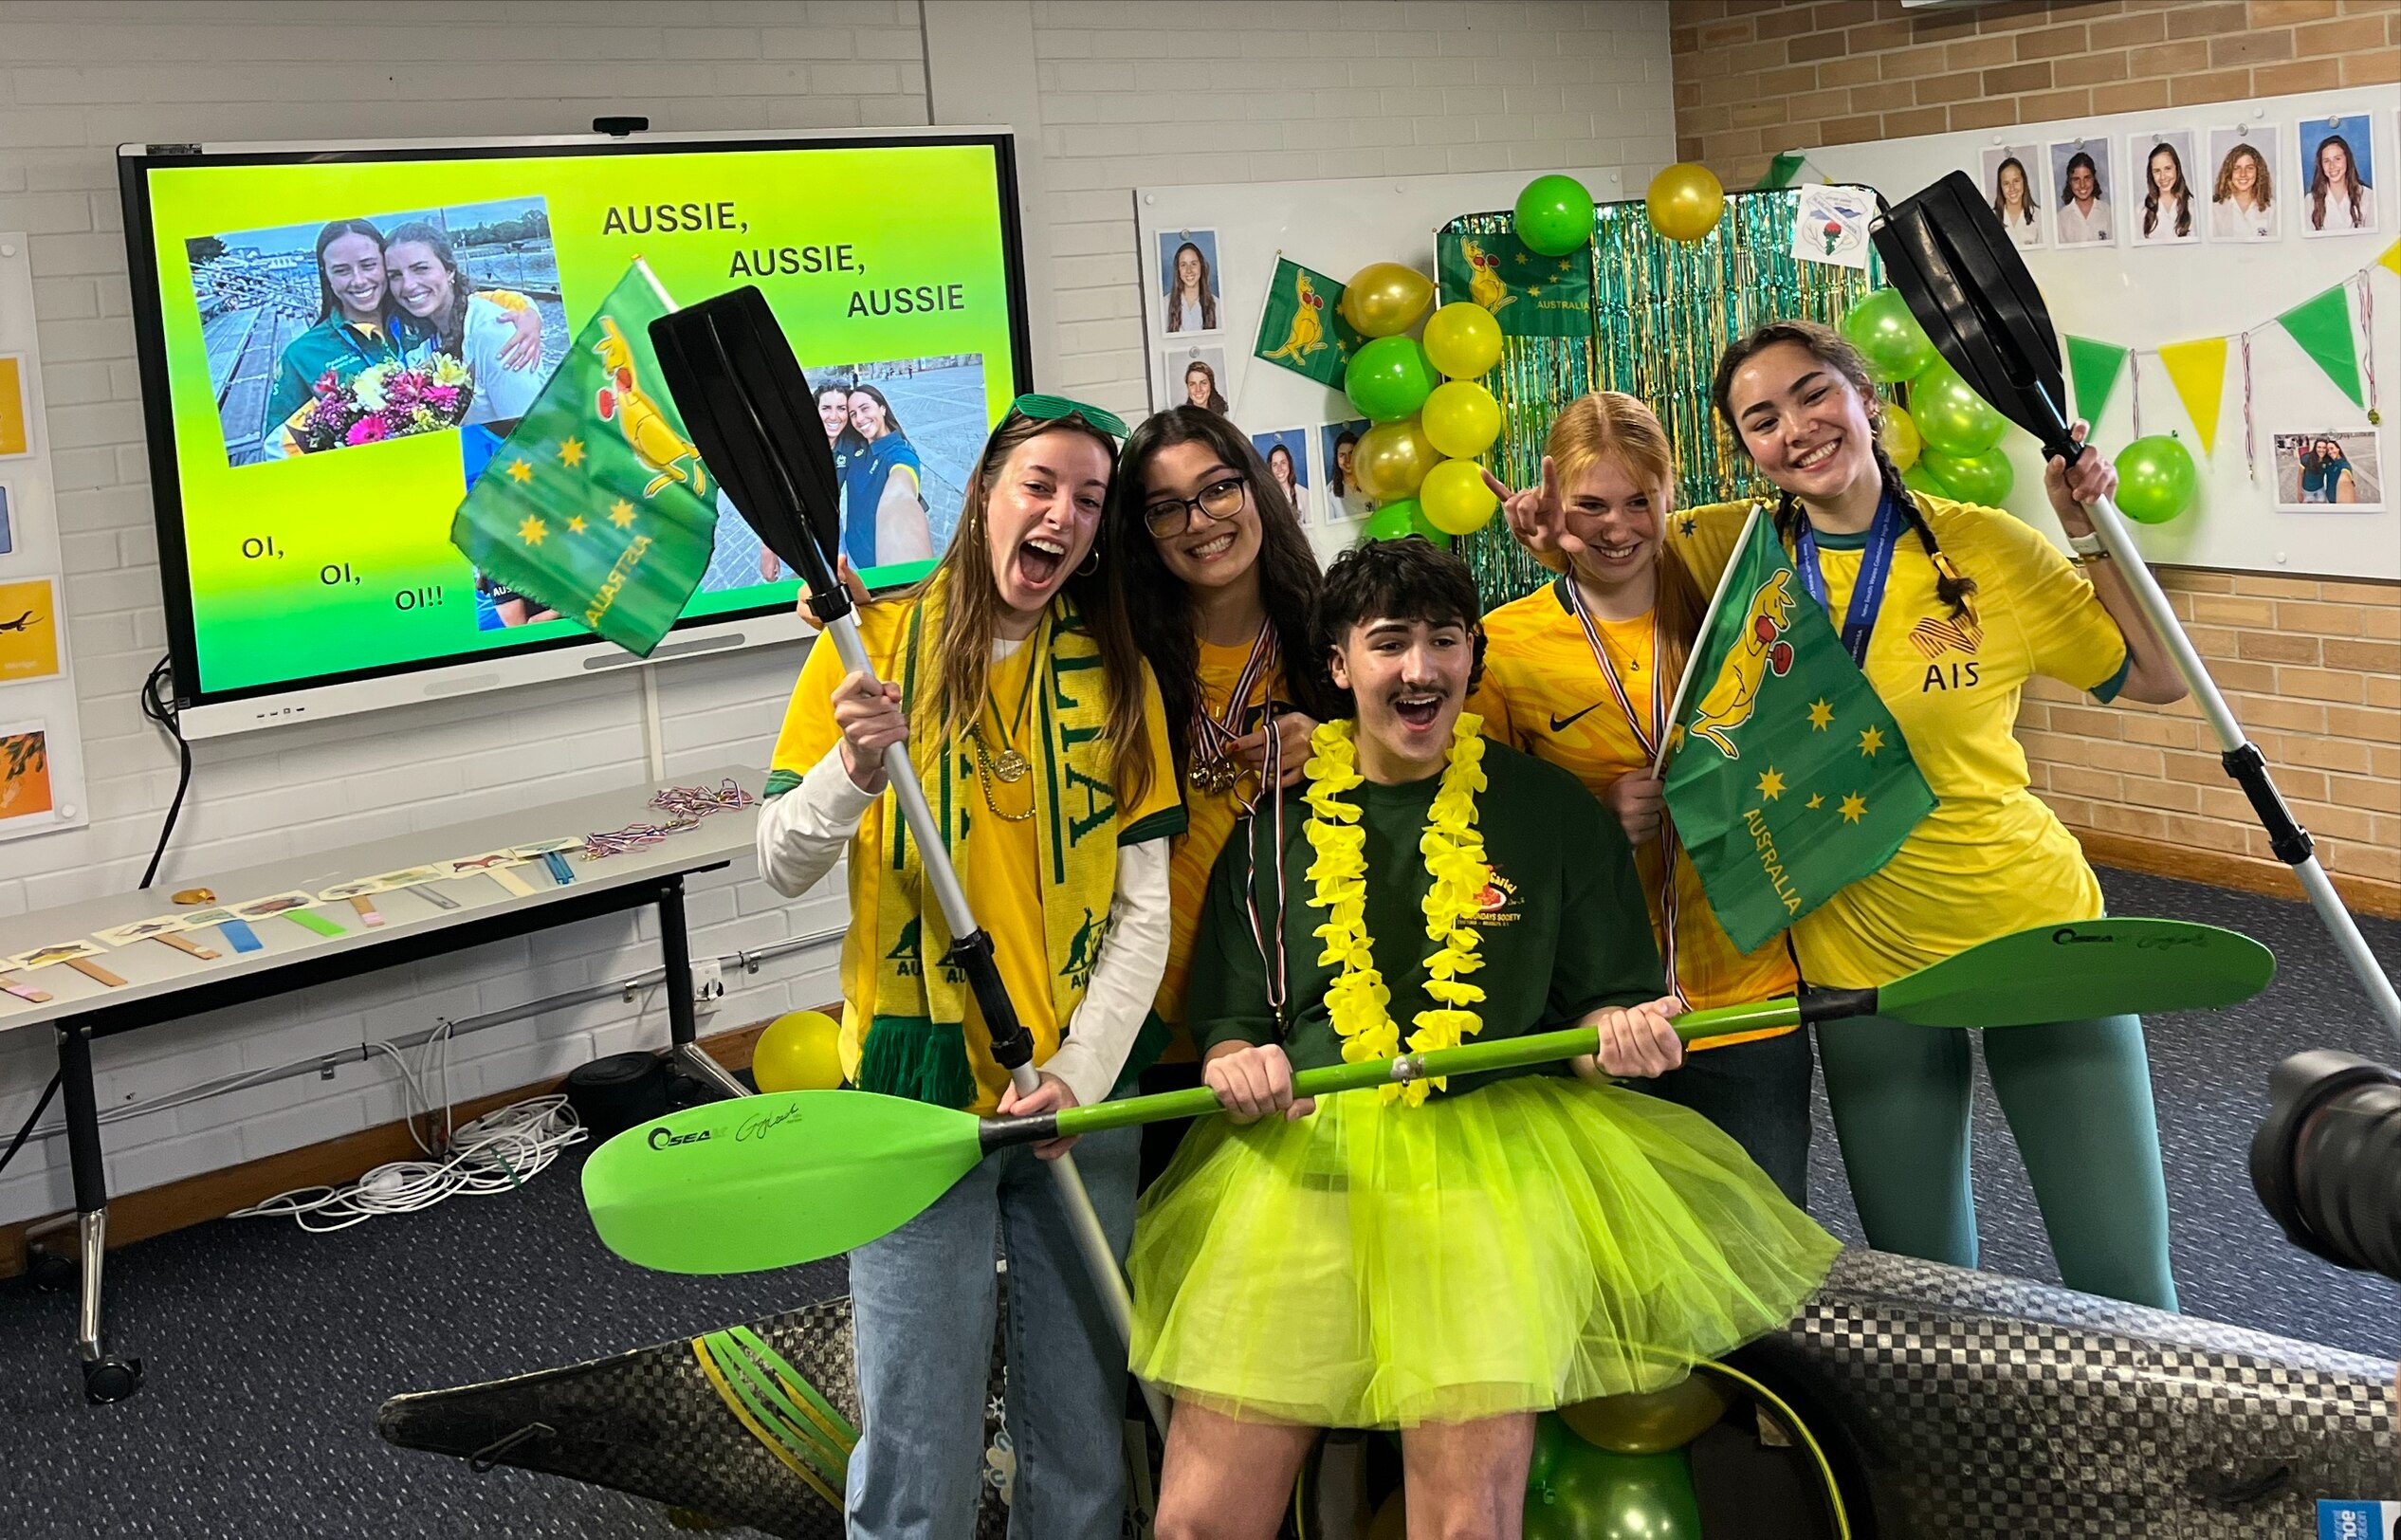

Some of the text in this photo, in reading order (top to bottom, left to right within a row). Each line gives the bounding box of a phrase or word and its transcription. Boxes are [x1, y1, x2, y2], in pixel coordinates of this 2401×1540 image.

[602, 202, 748, 235] AUSSIE,
[729, 245, 866, 278] AUSSIE,
[847, 284, 964, 318] AUSSIE
[1536, 300, 1590, 310] AUSTRALIA
[242, 536, 284, 559] OI,
[1873, 538, 1885, 567] Combined
[320, 563, 360, 585] OI,
[394, 585, 443, 611] OI!!
[1922, 662, 1979, 692] AIS
[1050, 621, 1117, 848] LIA
